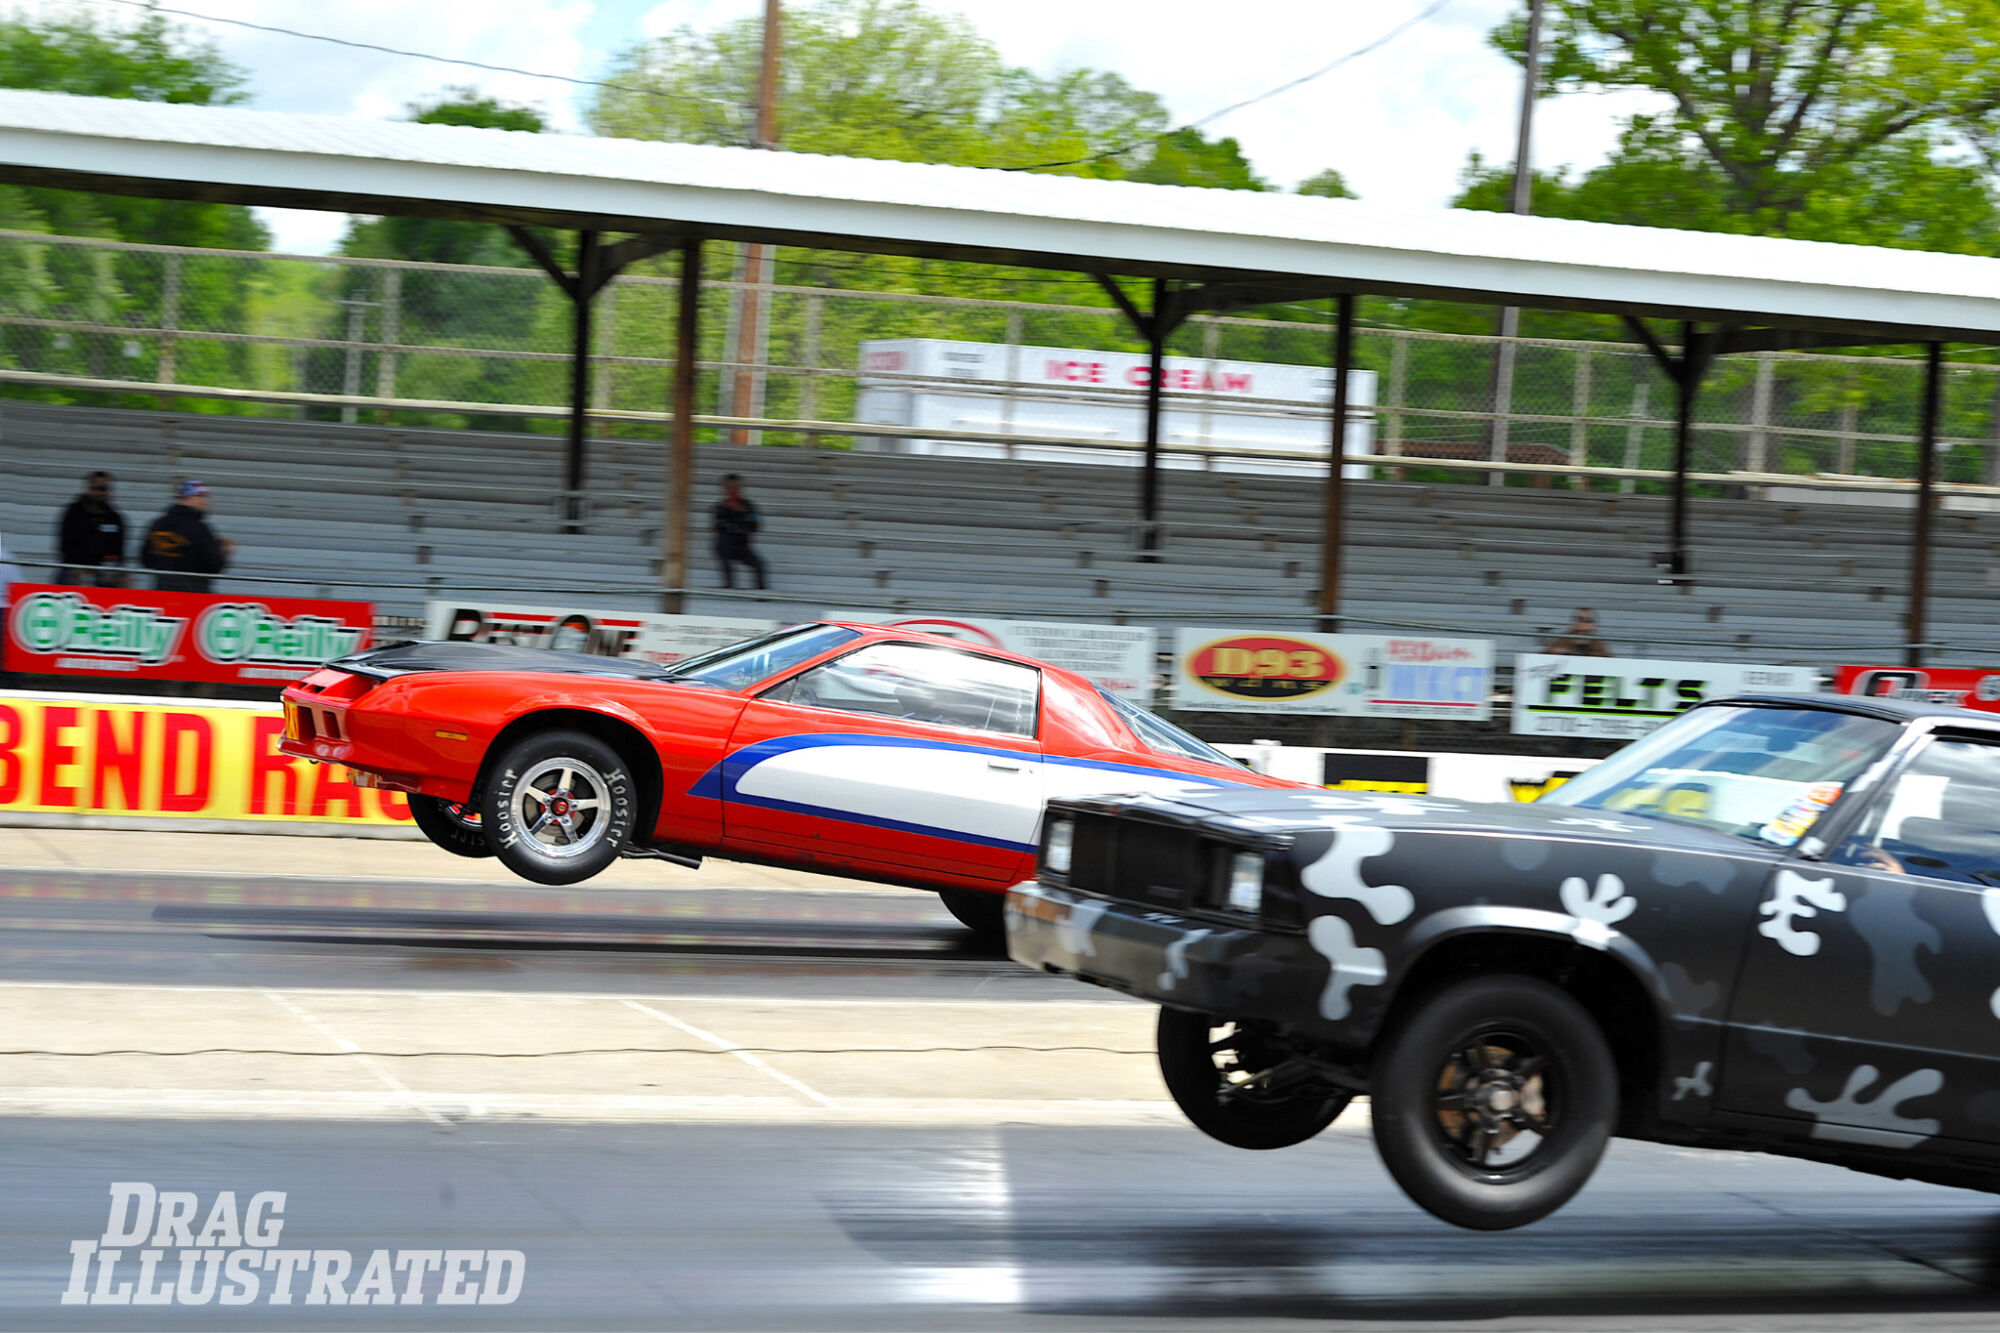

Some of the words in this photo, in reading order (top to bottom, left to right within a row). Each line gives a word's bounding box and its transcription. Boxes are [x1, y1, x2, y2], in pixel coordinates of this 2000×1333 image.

[1046, 359, 1105, 383] ICE
[1124, 366, 1253, 393] CREAM
[14, 592, 188, 665] O'Reilly
[1211, 647, 1325, 678] D93
[1549, 674, 1707, 712] FELTS
[497, 768, 520, 849] Hoosier
[603, 768, 629, 848] Hoosier
